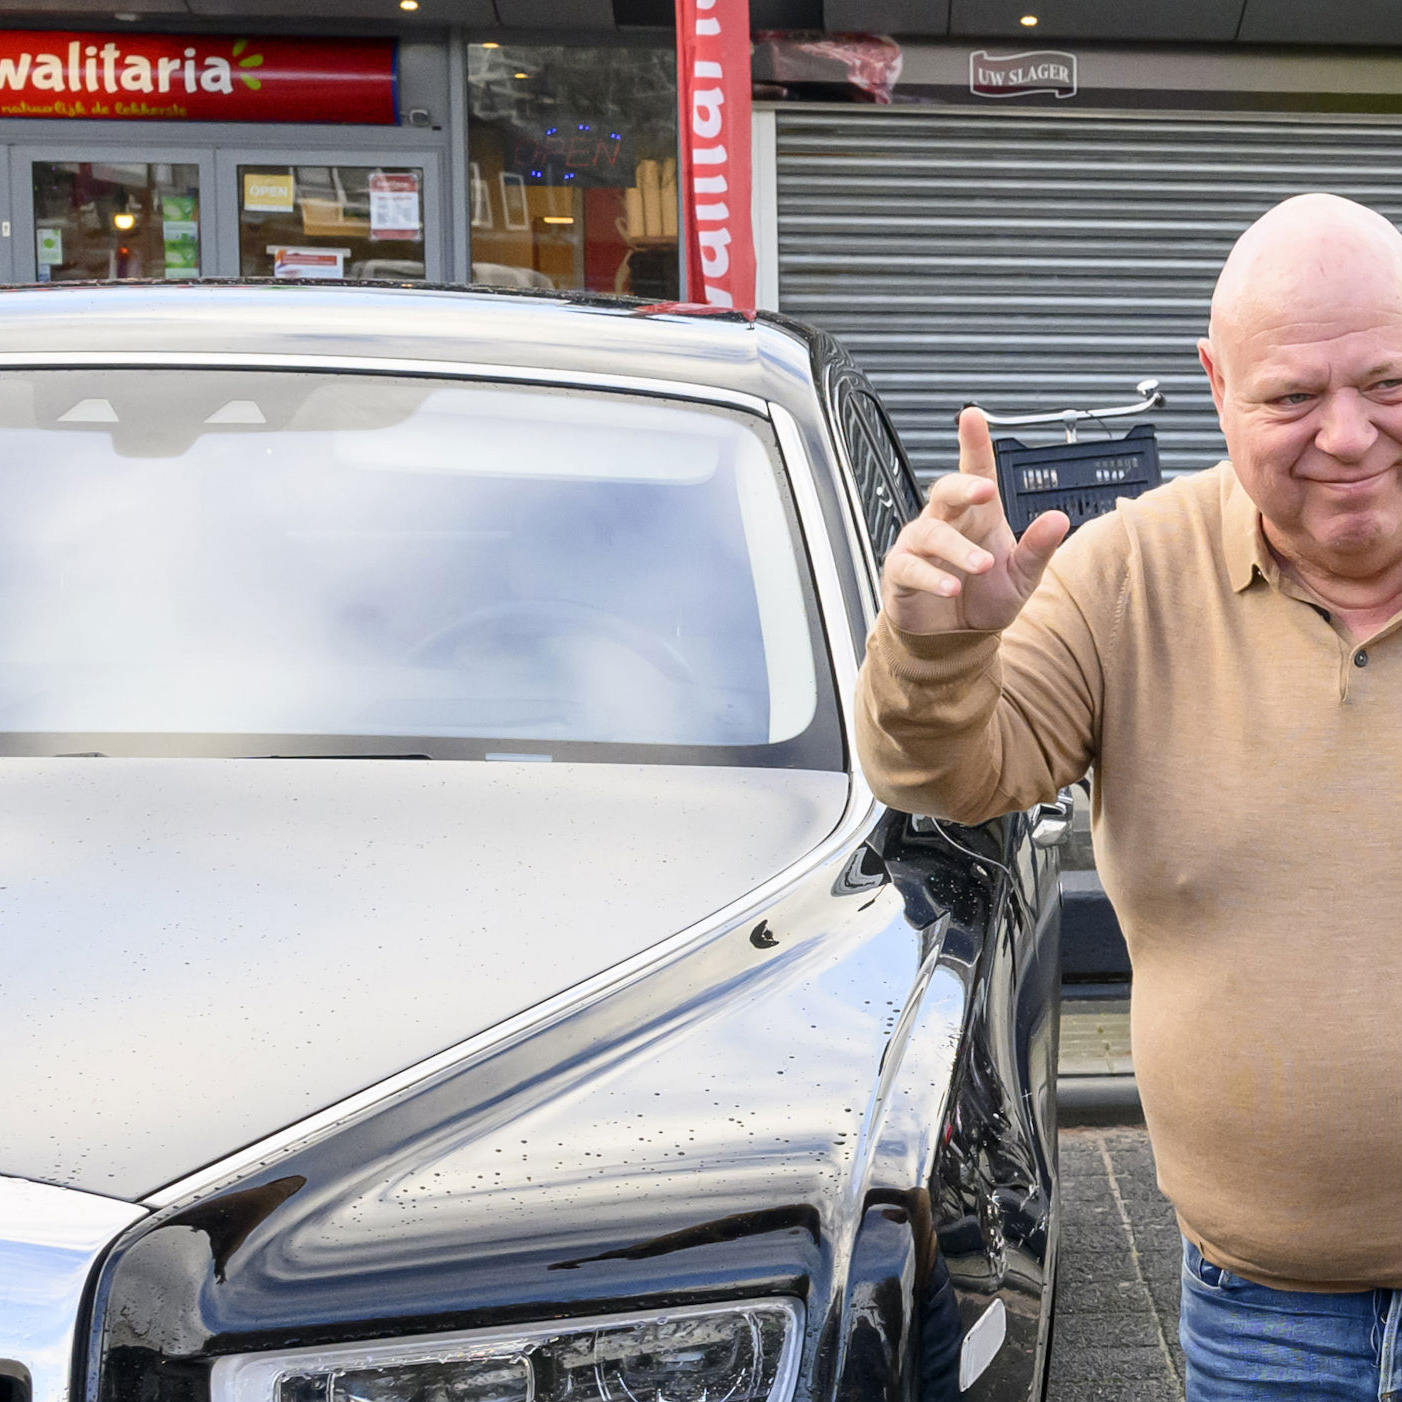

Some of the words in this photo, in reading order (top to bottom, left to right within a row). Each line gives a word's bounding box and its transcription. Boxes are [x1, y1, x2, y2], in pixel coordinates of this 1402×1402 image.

[978, 67, 1006, 86] UW
[1008, 63, 1070, 86] SLAGER
[91, 100, 109, 114] de
[249, 184, 288, 199] OPEN
